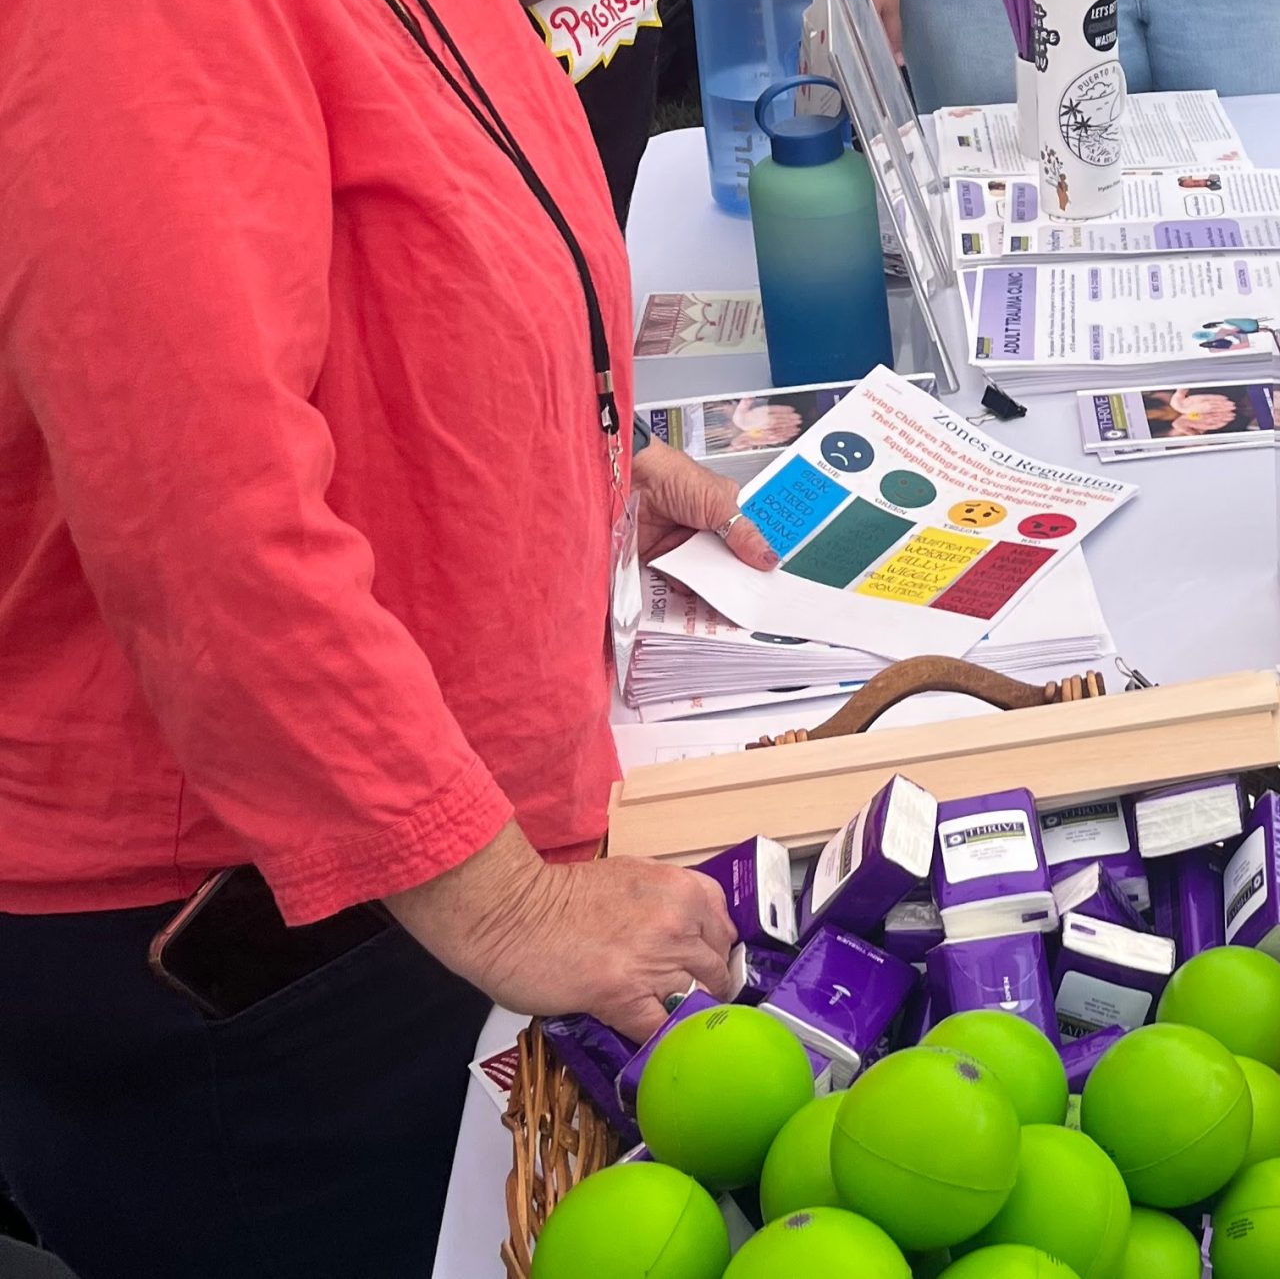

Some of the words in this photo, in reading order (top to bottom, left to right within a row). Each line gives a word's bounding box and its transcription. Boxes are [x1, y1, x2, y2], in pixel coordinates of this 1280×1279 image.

[1091, 5, 1108, 19] LET'S
[1078, 67, 1109, 91] PUERTO
[1007, 272, 1022, 293] CLINIC
[1005, 295, 1021, 325] TRAUMA
[1002, 327, 1020, 353] ADULT
[1095, 396, 1112, 429] THRIVE
[871, 410, 897, 432] Their
[898, 428, 916, 446] Big
[916, 439, 958, 473] Feelings
[980, 476, 1021, 495] Crucial
[1022, 487, 1047, 499] First
[1048, 493, 1076, 508] Step
[895, 408, 937, 443] Children
[938, 440, 958, 457] The
[958, 452, 994, 477] Ability
[995, 469, 1007, 479] to
[1008, 473, 1052, 494] Identify
[932, 410, 987, 453] Zones
[992, 449, 1013, 466] of
[1015, 458, 1125, 492] Regulation
[800, 469, 829, 494] SICK
[816, 460, 842, 479] BLUE
[882, 435, 934, 476] Equipping
[936, 469, 966, 490] Them
[968, 484, 980, 494] to
[980, 487, 1054, 511] Self-Regulate
[777, 485, 815, 517] TIRED
[792, 481, 819, 501] SAD
[763, 494, 805, 529] BORED
[874, 497, 908, 516] GREEN
[747, 501, 800, 542] MOVING
[905, 545, 972, 564] WORRIED
[910, 534, 988, 556] FRUSTRATED
[887, 564, 947, 583] WIGGLY
[1062, 802, 1118, 820] THRIVE
[966, 821, 1024, 838] THRIVE
